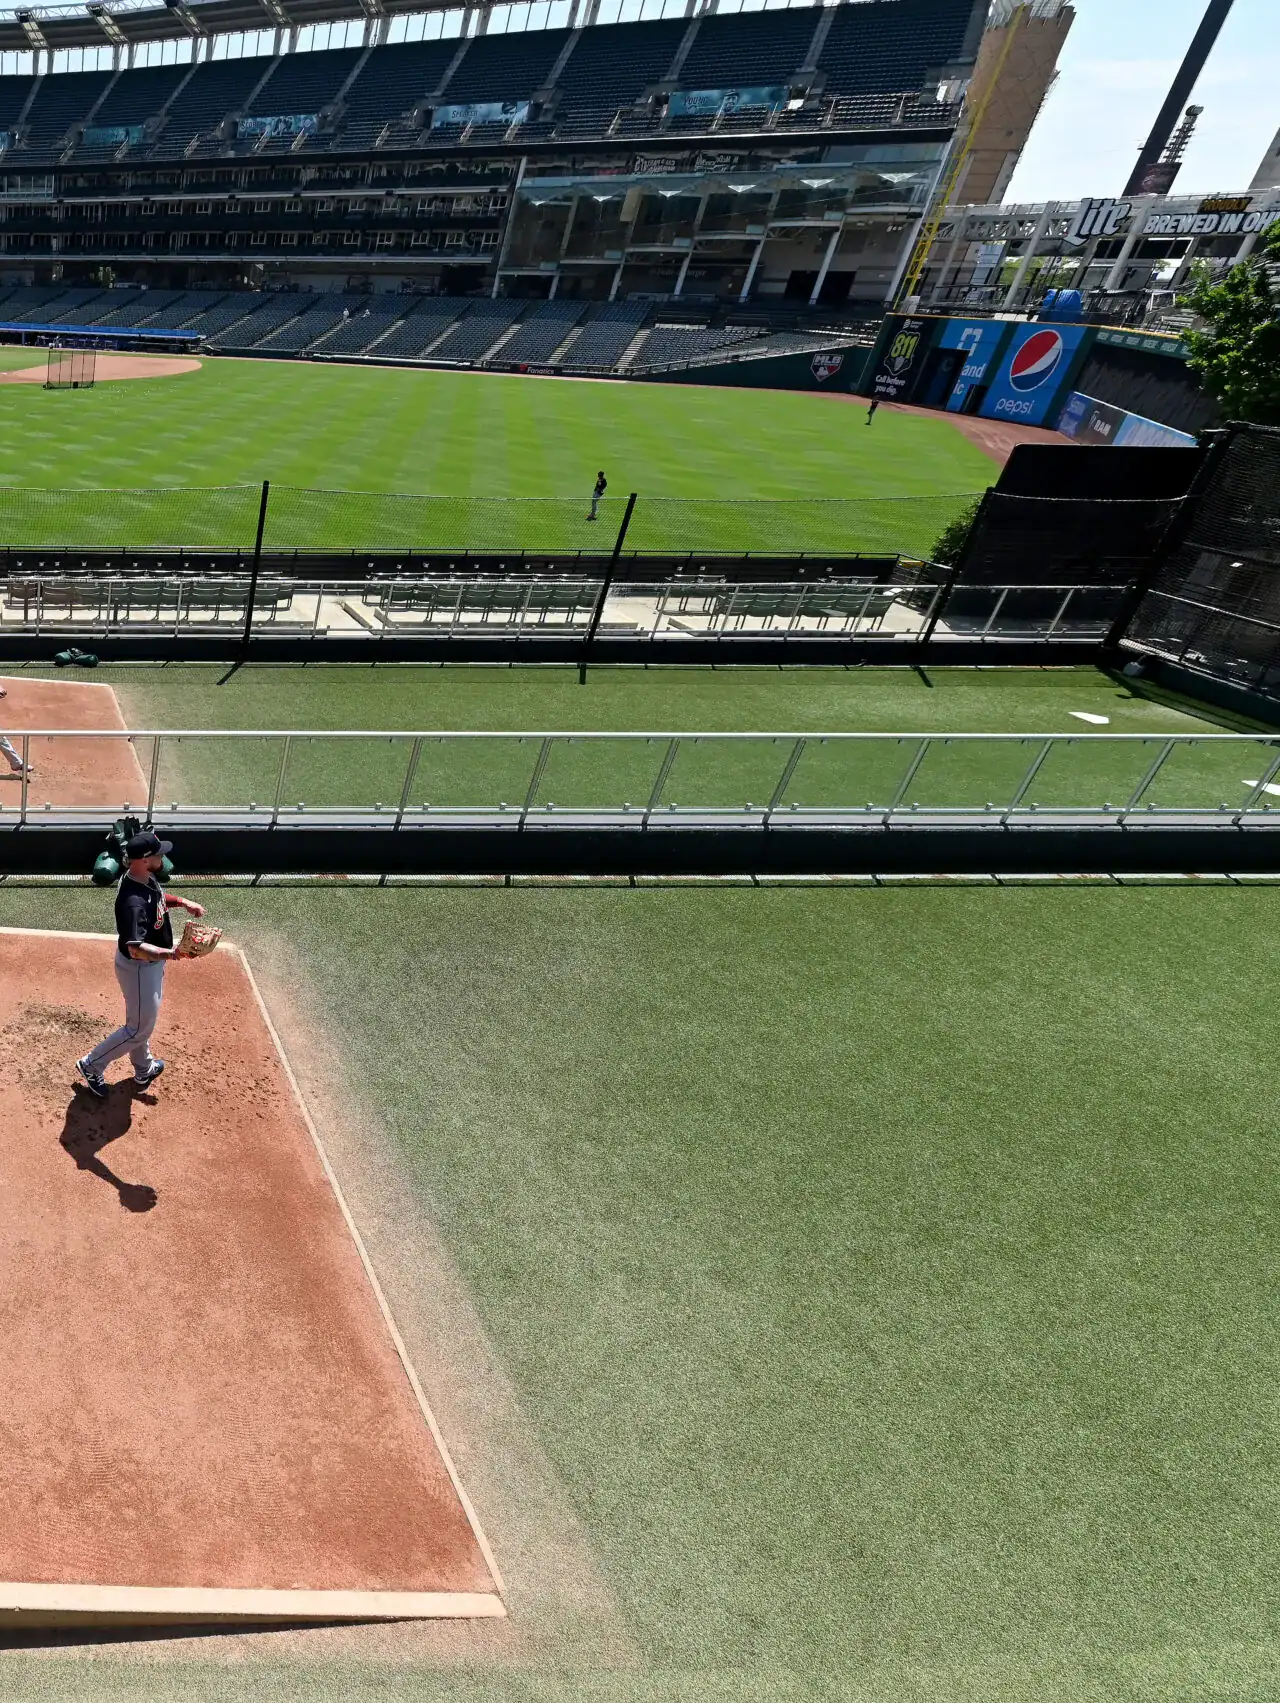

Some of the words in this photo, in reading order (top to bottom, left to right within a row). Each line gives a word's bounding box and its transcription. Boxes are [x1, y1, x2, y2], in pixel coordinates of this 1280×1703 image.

[1064, 198, 1131, 247] Lite
[1142, 213, 1219, 235] BREWED
[1219, 212, 1244, 235] IN
[890, 333, 918, 359] 811
[875, 374, 886, 383] Call
[886, 375, 906, 387] before
[994, 398, 1036, 416] pepsi
